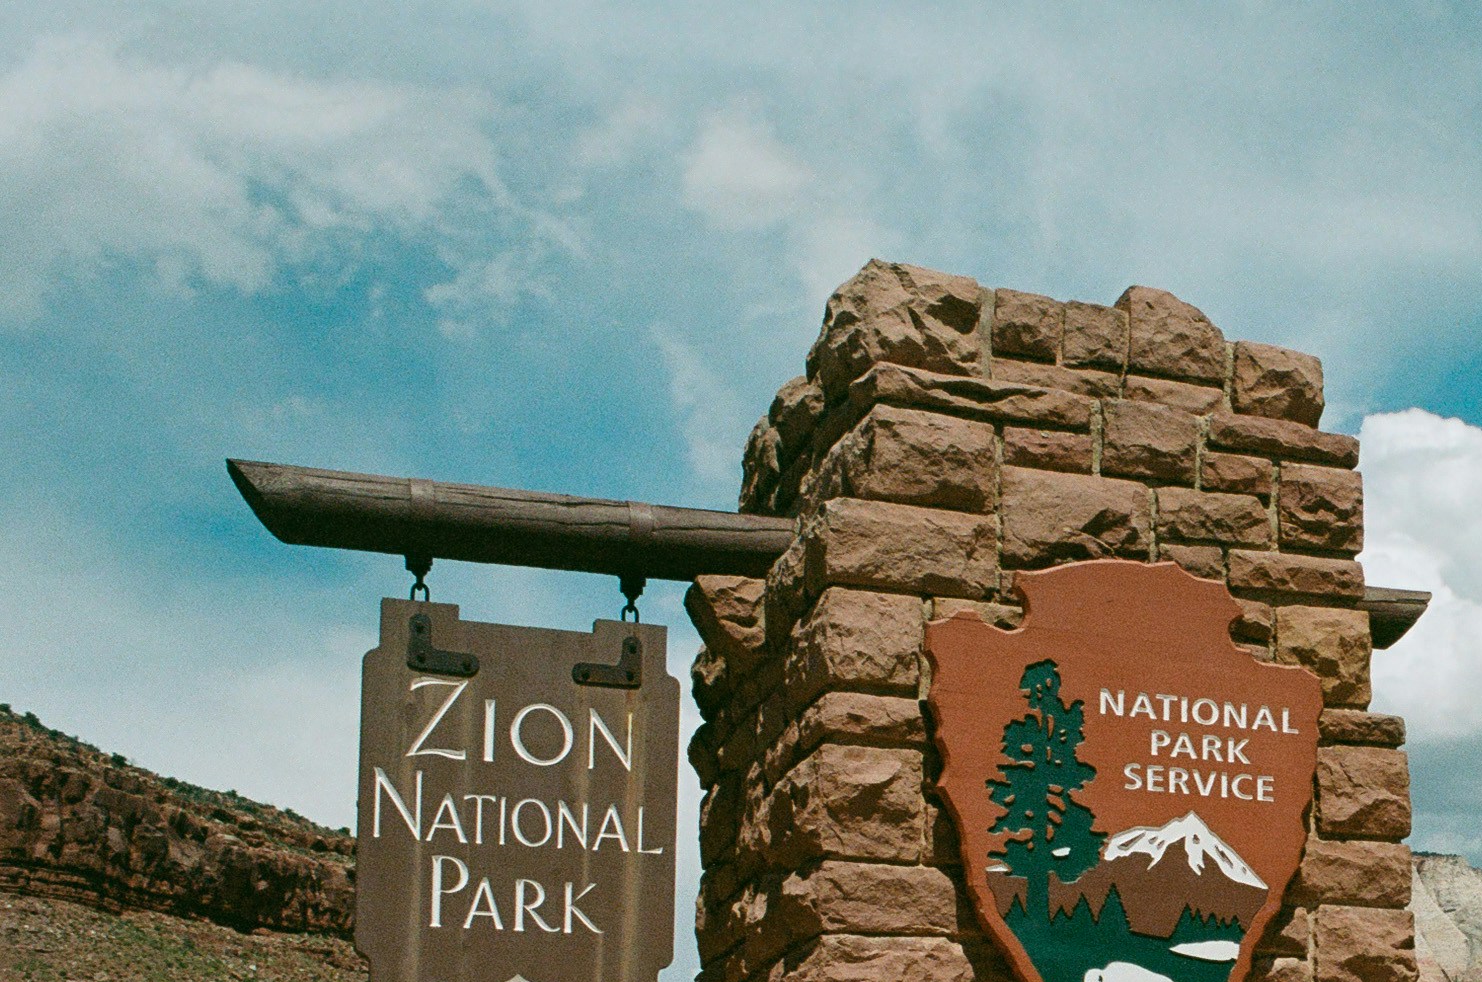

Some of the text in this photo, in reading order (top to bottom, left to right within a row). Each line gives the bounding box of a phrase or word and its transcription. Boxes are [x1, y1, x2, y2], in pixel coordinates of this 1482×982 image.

[406, 677, 633, 770] ZION
[1099, 688, 1299, 734] NATIONAL
[1150, 730, 1251, 764] PARK
[373, 767, 663, 853] NATIONAL
[1123, 763, 1275, 802] SERVICE
[429, 855, 604, 933] PARK
